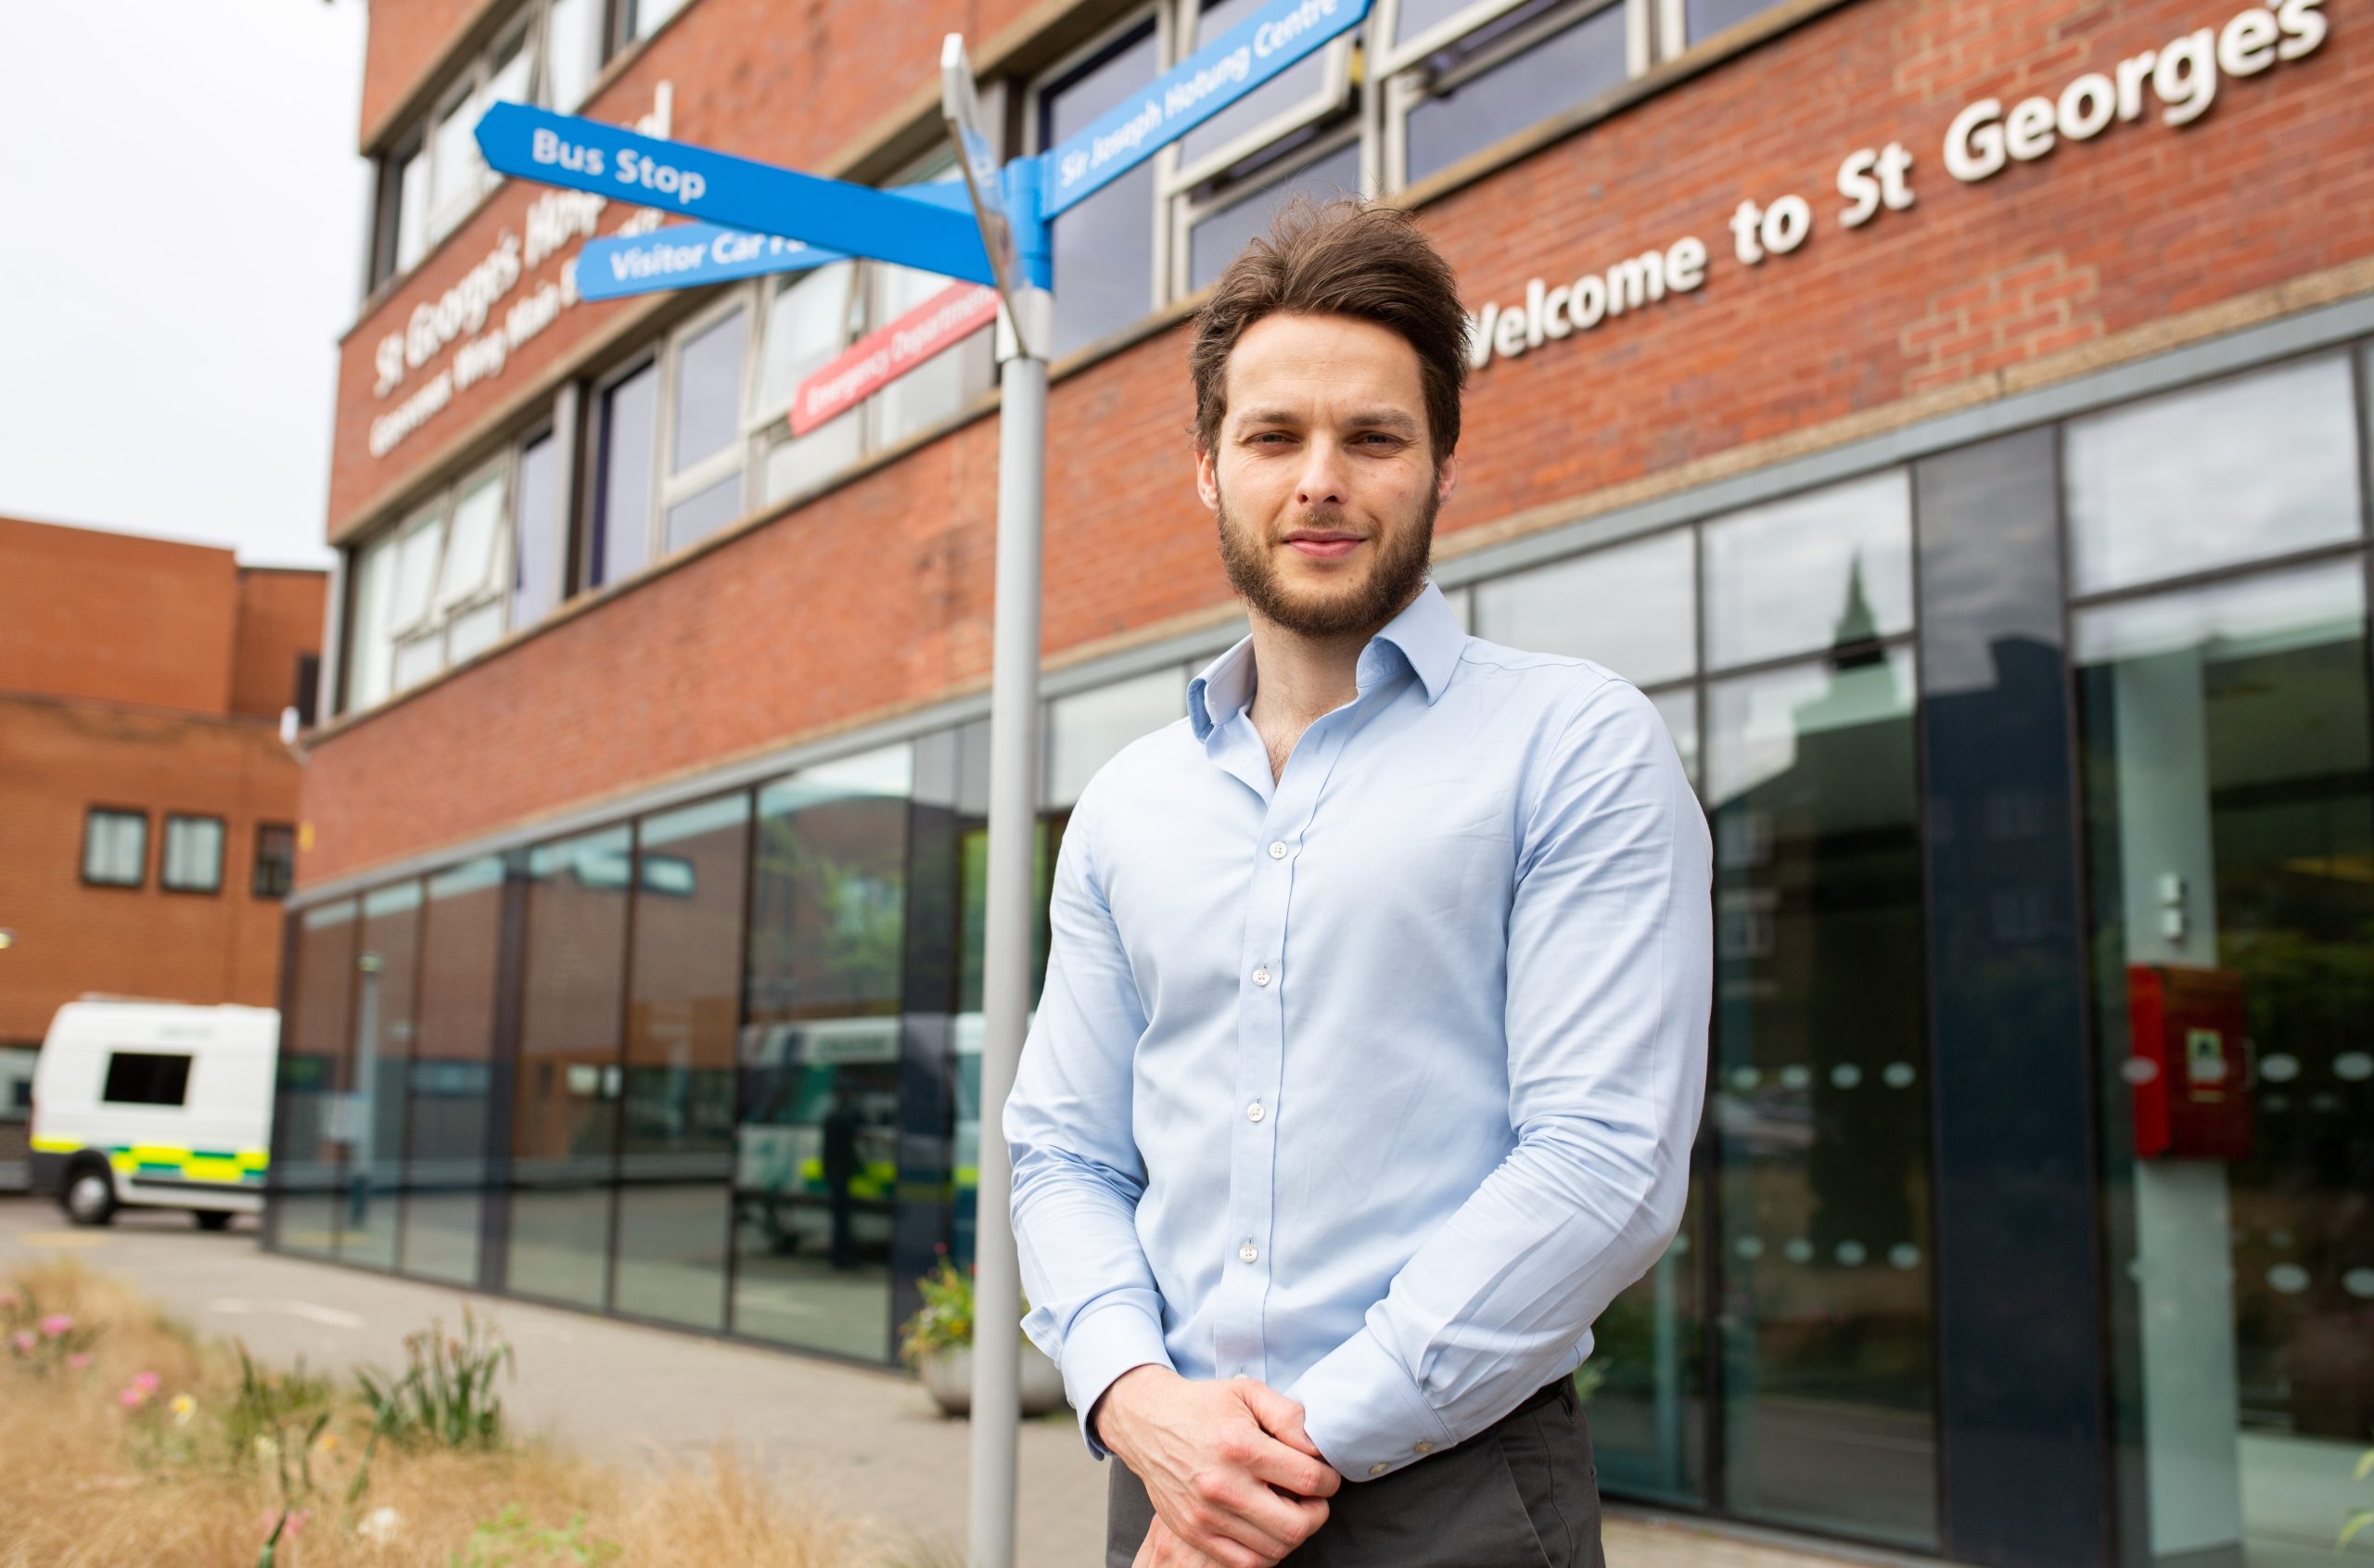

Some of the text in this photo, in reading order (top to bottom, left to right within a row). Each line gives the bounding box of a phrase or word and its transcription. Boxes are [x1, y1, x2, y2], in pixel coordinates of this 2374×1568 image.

[1062, 0, 1337, 186] Sir Joseph Hotung Centre
[532, 128, 707, 205] Bus Stop
[1730, 194, 1810, 264] to
[1837, 142, 1915, 228] St
[609, 243, 708, 281] Visitor
[711, 232, 766, 264] Car
[806, 286, 998, 417] Emergency Department
